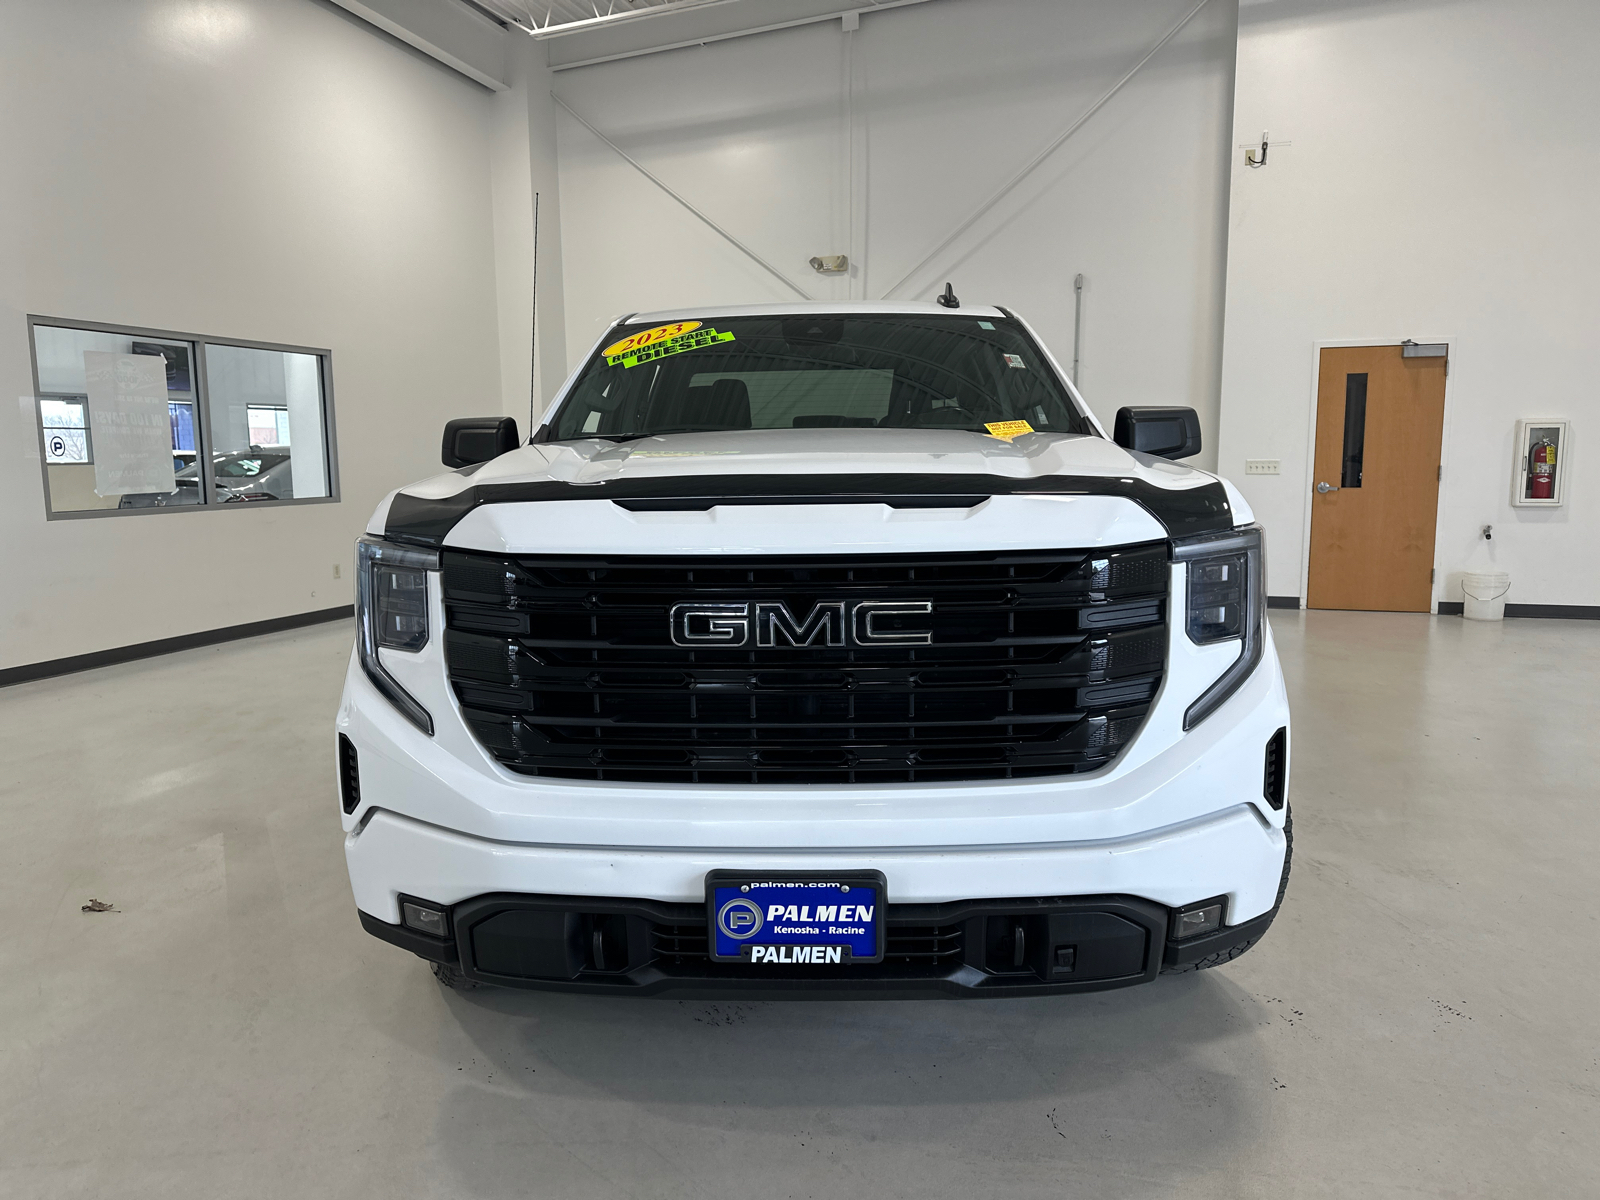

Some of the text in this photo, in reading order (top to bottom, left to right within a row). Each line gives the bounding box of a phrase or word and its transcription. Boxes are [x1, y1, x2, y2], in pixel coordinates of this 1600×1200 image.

[612, 329, 714, 363] REMOTE START
[620, 324, 683, 352] 2023
[636, 335, 726, 363] DIESEL
[54, 442, 63, 452] P
[669, 599, 933, 648] GMC
[750, 881, 841, 889] palmen.com
[766, 905, 874, 922] PALMEN
[774, 926, 820, 935] Kenosha
[828, 926, 865, 935] Racine
[750, 946, 842, 964] PALMEN
